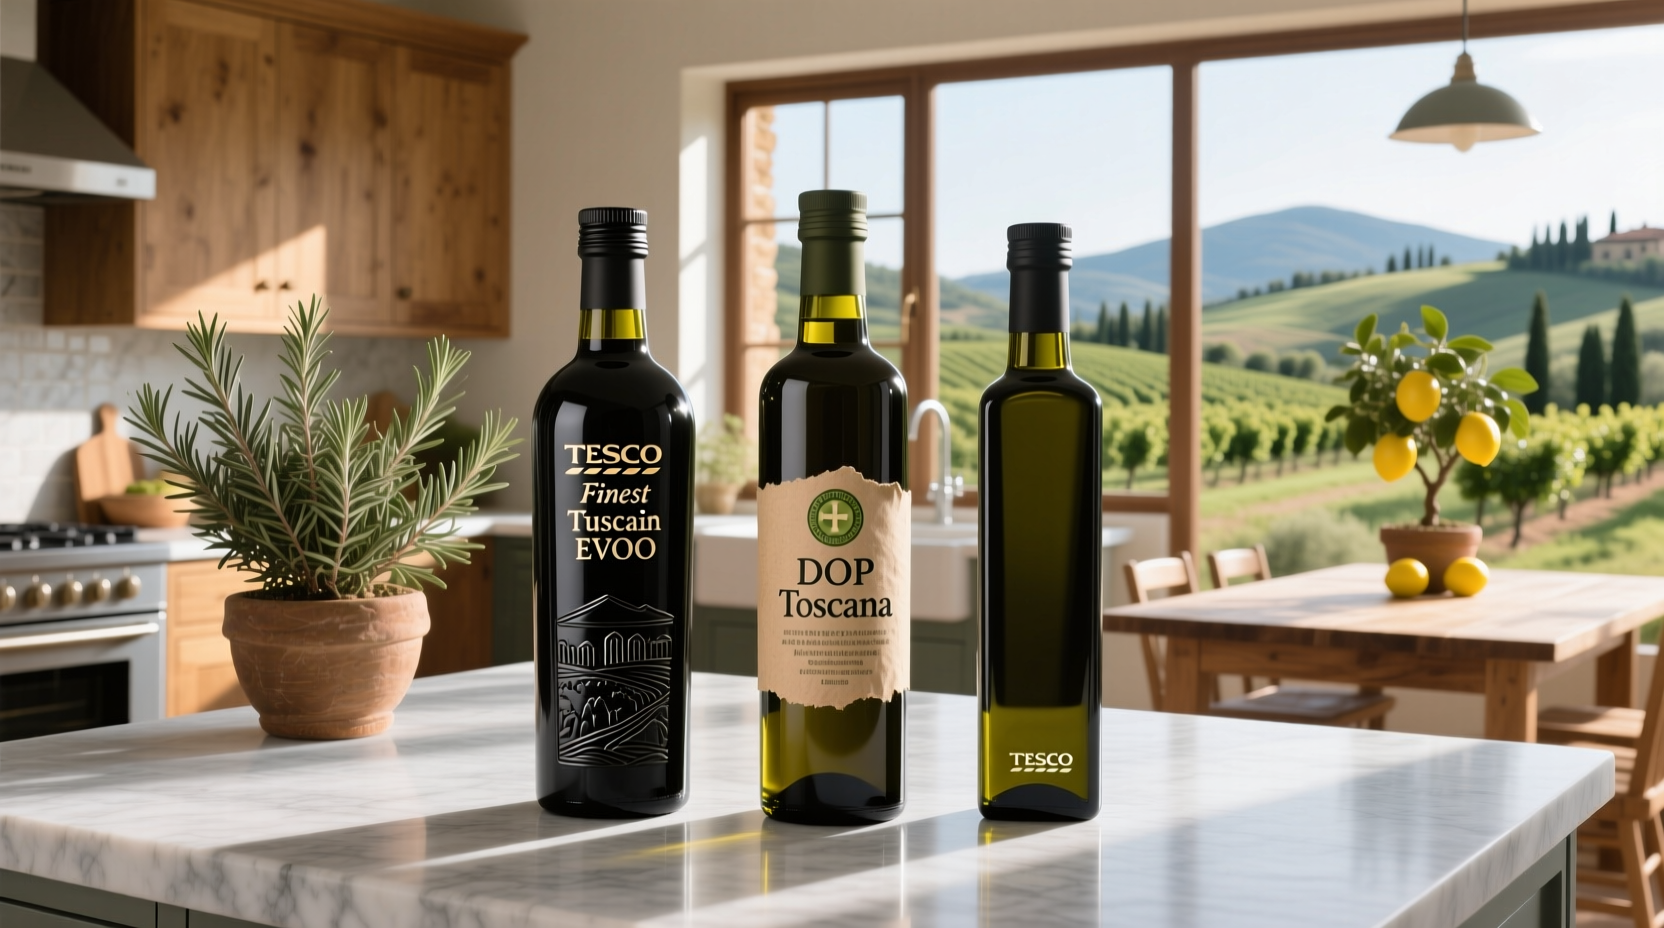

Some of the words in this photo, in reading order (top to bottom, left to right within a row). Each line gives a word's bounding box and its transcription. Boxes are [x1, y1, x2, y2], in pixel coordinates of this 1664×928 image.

[564, 444, 662, 464] TESCO
[580, 482, 651, 504] Finest
[567, 509, 661, 532] Tuscain
[575, 537, 656, 560] EVOO
[797, 558, 874, 586] DOP
[779, 589, 893, 618] Toscana
[1009, 752, 1073, 766] TESCO
